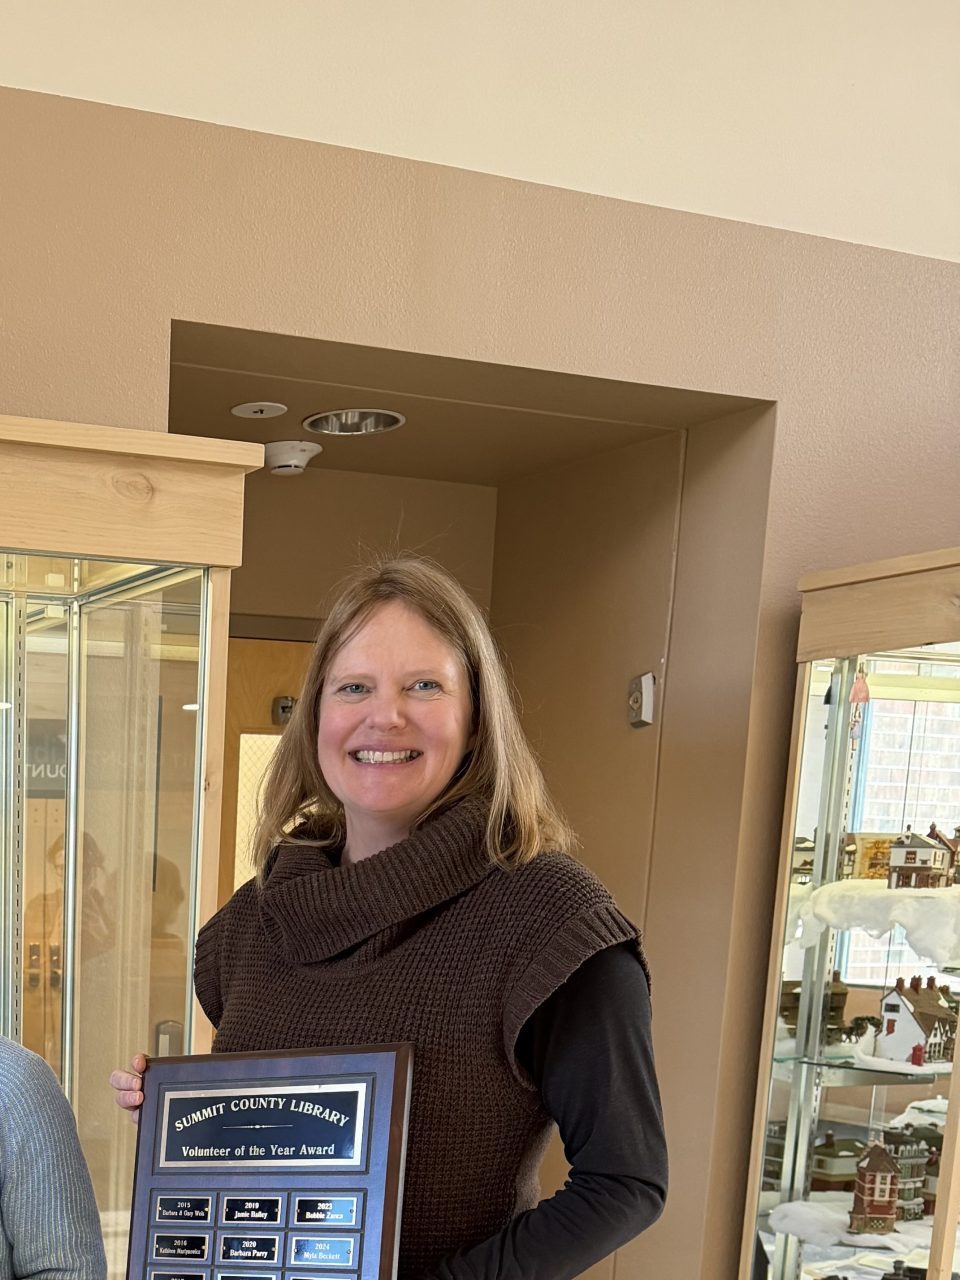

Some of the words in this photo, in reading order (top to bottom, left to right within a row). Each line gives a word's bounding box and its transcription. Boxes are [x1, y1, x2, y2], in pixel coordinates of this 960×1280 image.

[175, 1103, 226, 1132] SUMMIT
[230, 1097, 286, 1111] COUNTY
[290, 1099, 350, 1127] LIBRARY
[182, 1146, 231, 1156] Volunteer
[235, 1146, 245, 1156] of
[249, 1145, 266, 1156] the
[270, 1145, 295, 1155] Year
[300, 1144, 335, 1155] Award
[230, 1249, 251, 1257] Barbara
